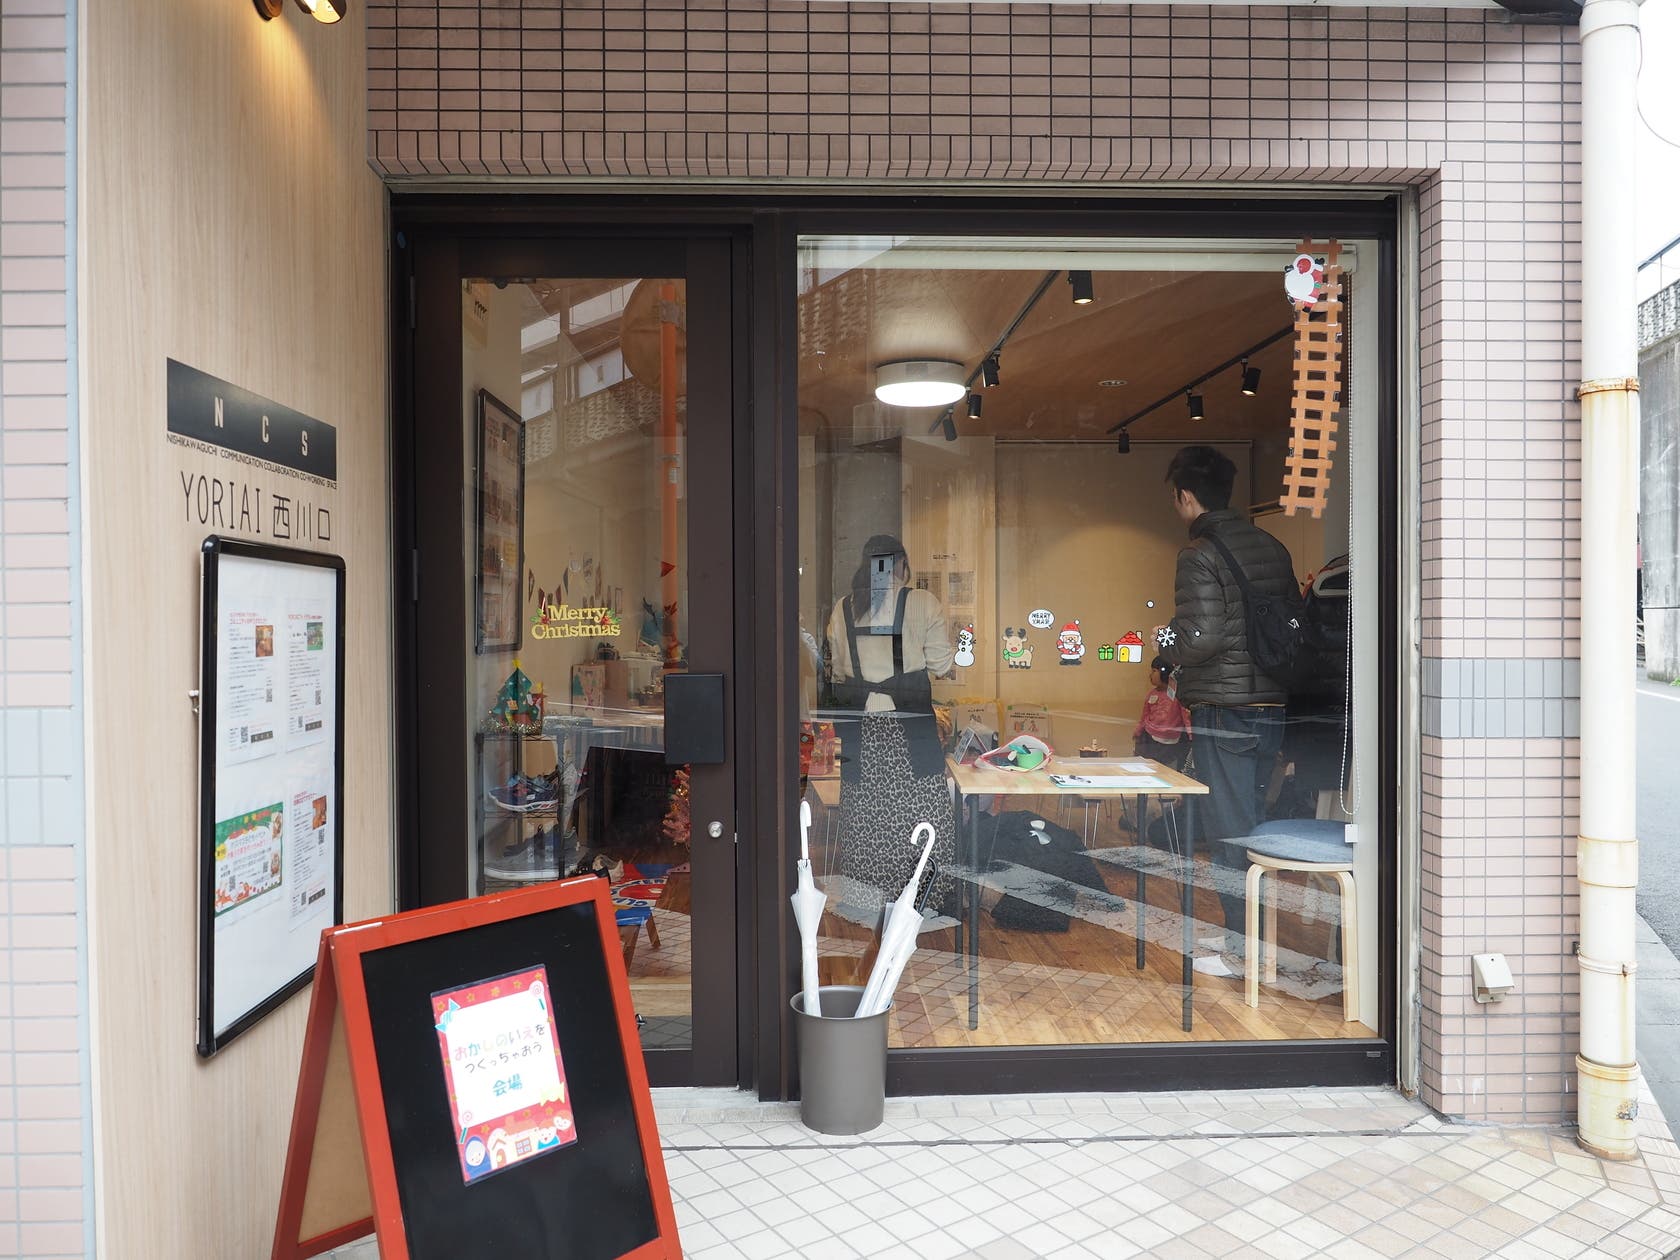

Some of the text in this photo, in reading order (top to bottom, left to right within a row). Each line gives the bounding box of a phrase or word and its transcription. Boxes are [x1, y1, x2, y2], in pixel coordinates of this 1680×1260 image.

[220, 448, 264, 469] COMMUNICATION
[263, 461, 300, 480] COLLABORATION
[180, 470, 331, 542] YORIAI 西川口
[547, 604, 609, 623] Merry
[531, 621, 621, 639] Christmas
[454, 1024, 545, 1061] おかしのいえを
[464, 1042, 542, 1074] つくっちゃおう
[493, 1073, 523, 1097] 会場
